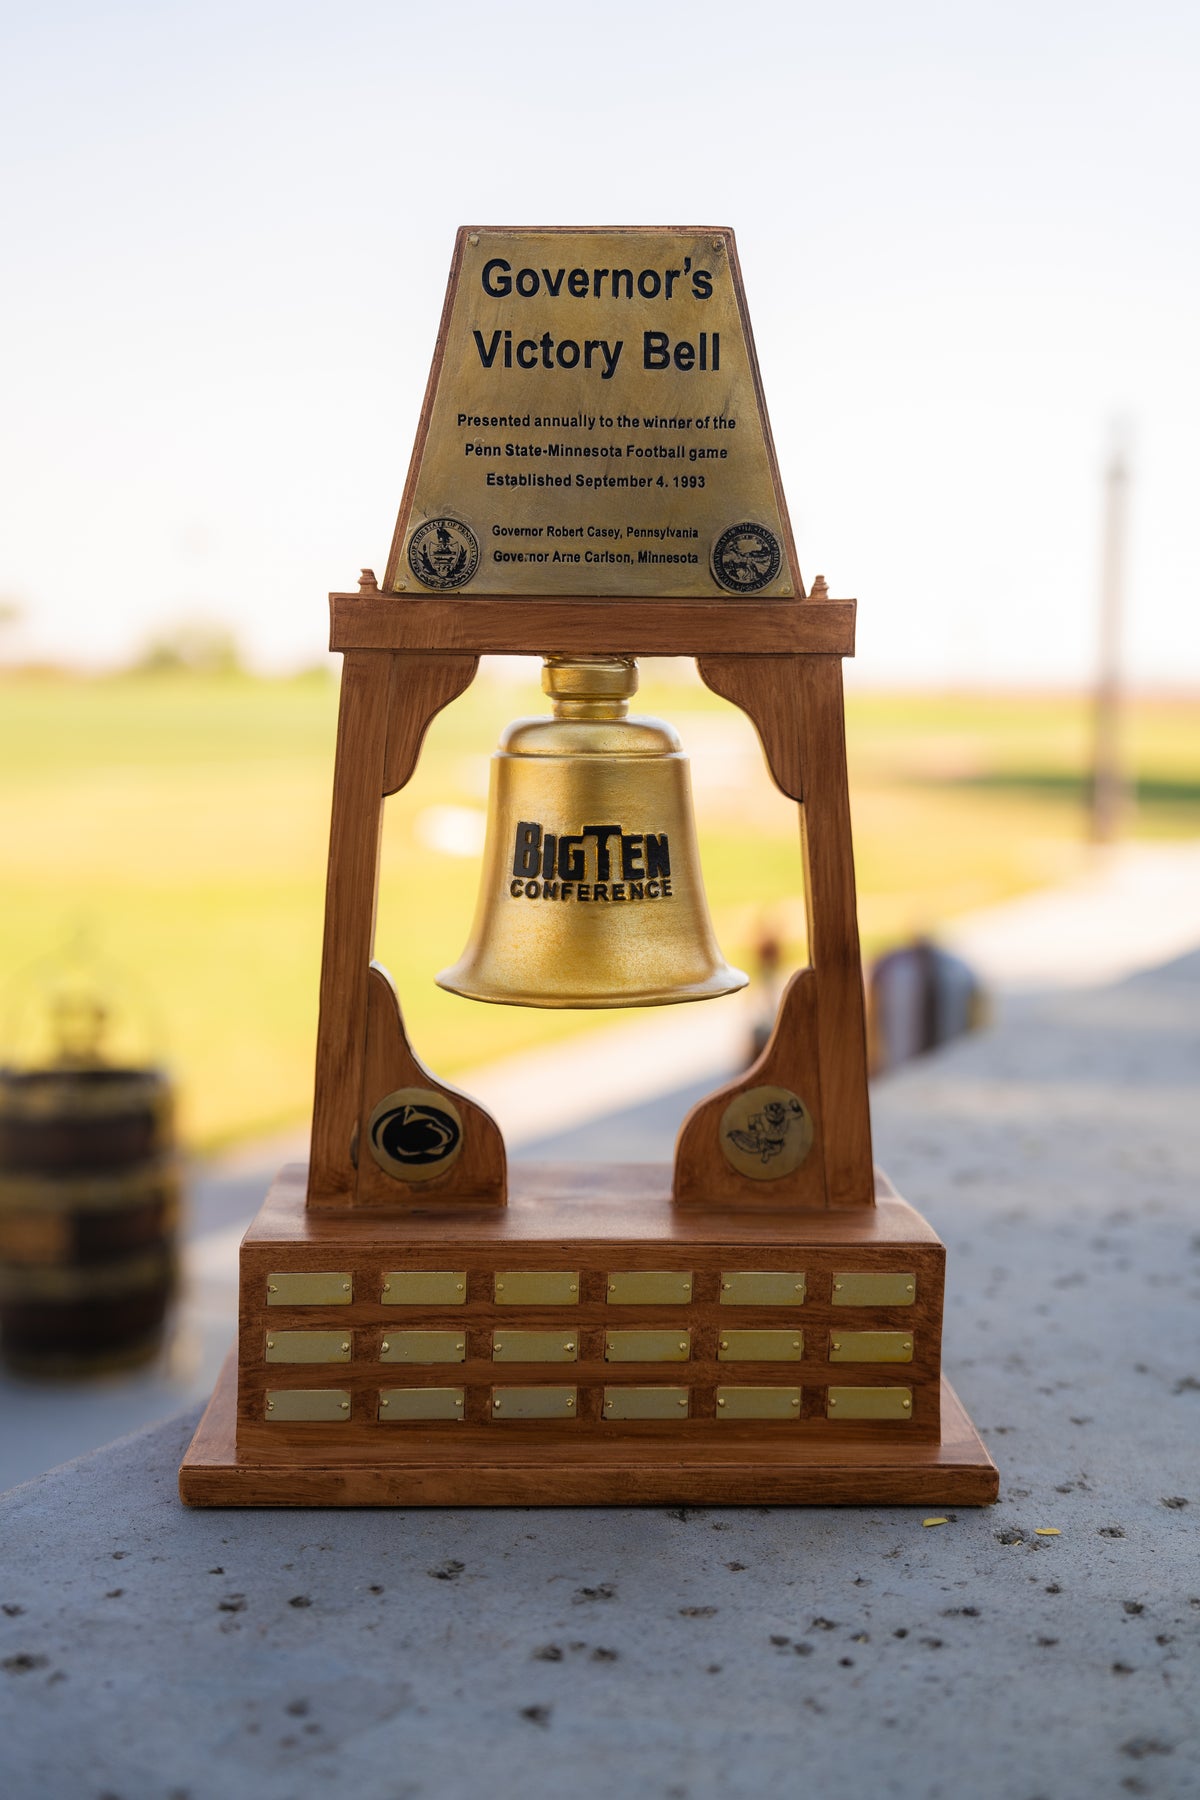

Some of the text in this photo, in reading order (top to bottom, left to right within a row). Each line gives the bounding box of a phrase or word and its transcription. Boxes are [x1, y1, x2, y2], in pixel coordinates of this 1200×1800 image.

[482, 257, 713, 300] Governor's
[473, 330, 720, 379] Victory Bell
[457, 414, 736, 430] Presented annually to the winner of the
[465, 444, 728, 461] Penn State-Minnesota Football game
[486, 473, 572, 487] Established
[576, 474, 653, 489] September
[673, 476, 706, 488] 1993
[492, 525, 699, 540] Governor Robert Casey, Pennsylvania
[493, 551, 699, 565] Governor Arne Carlson, Minnesota
[513, 822, 671, 880] BIG TEN
[510, 879, 672, 901] CONFERENCE
